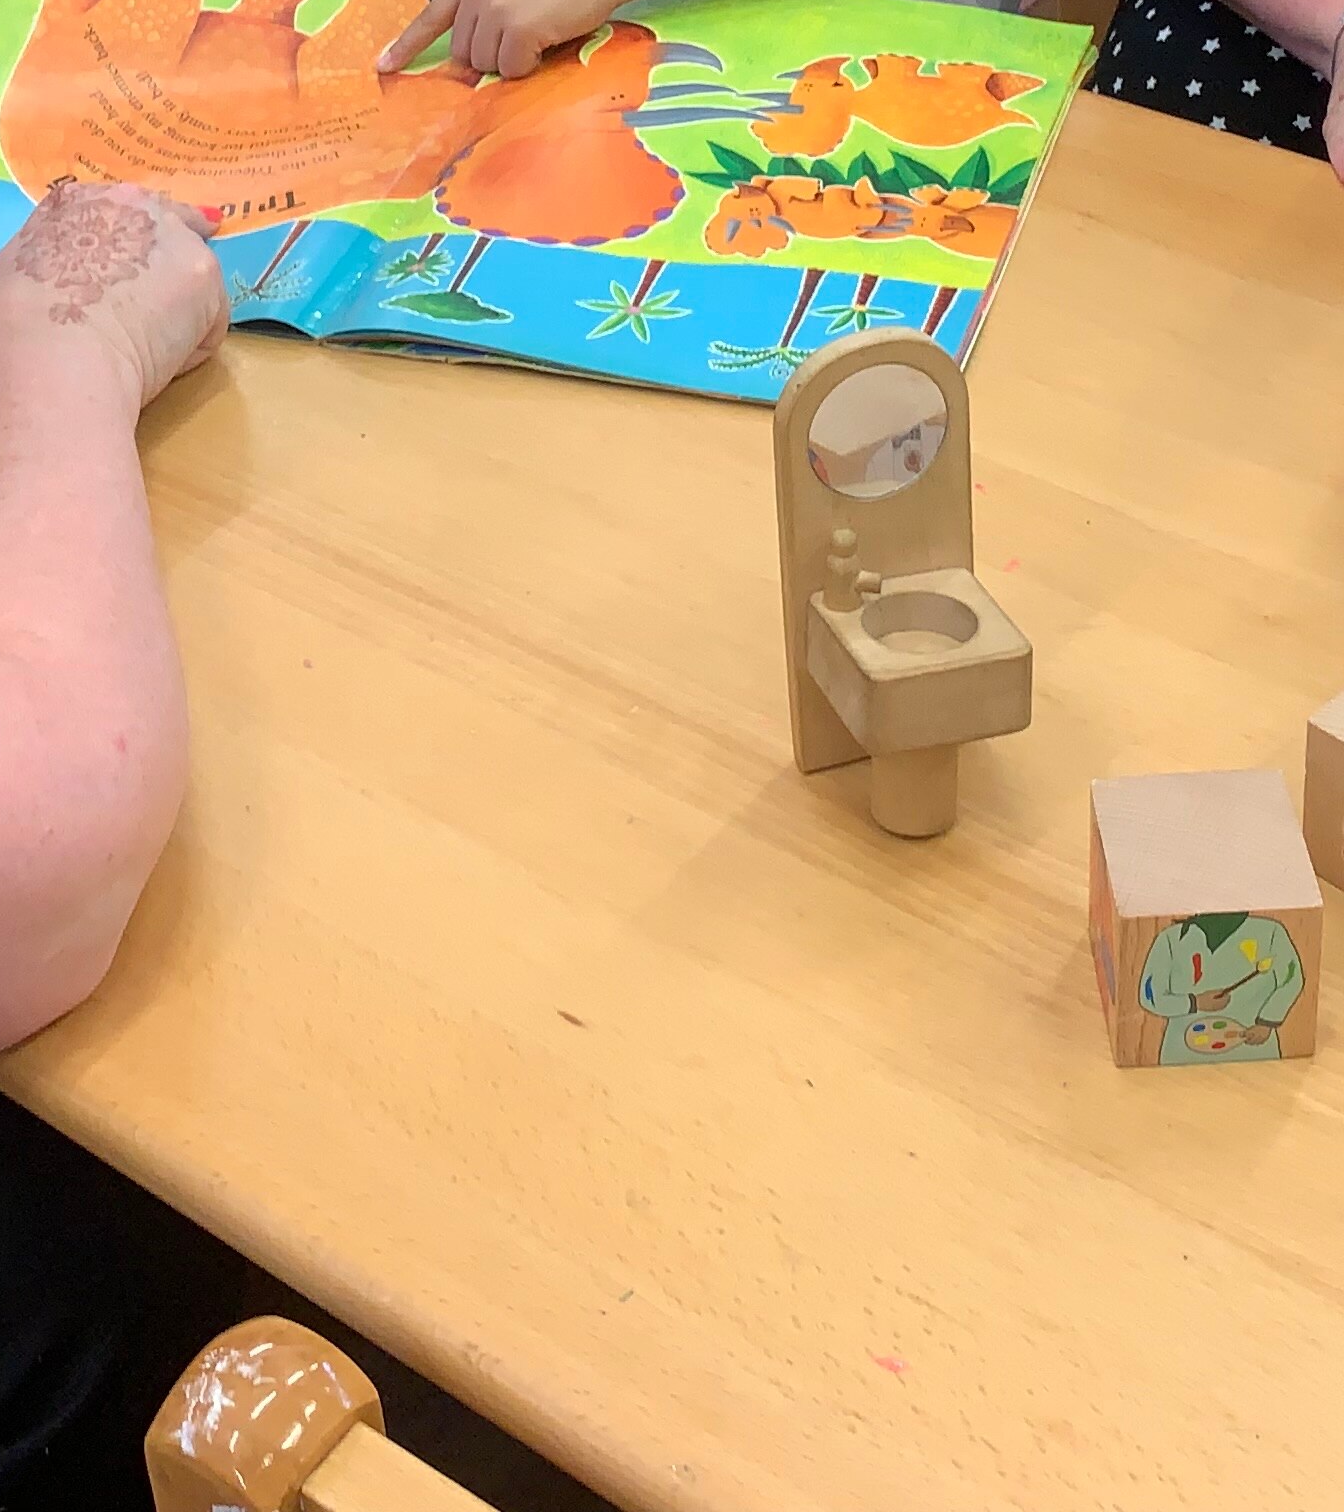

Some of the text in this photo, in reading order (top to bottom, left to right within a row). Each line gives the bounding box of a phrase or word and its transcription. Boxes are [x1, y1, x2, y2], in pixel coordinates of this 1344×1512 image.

[84, 23, 108, 62] back,
[104, 62, 144, 112] enemies
[136, 70, 163, 100] bed!
[88, 90, 119, 121] head
[162, 99, 177, 113] in
[81, 119, 105, 138] do?
[116, 120, 137, 138] my
[141, 112, 163, 130] my
[176, 111, 220, 134] comfy
[104, 137, 128, 157] you
[137, 135, 155, 149] on
[163, 127, 218, 152] keeping
[127, 156, 146, 167] do
[147, 165, 178, 177] how
